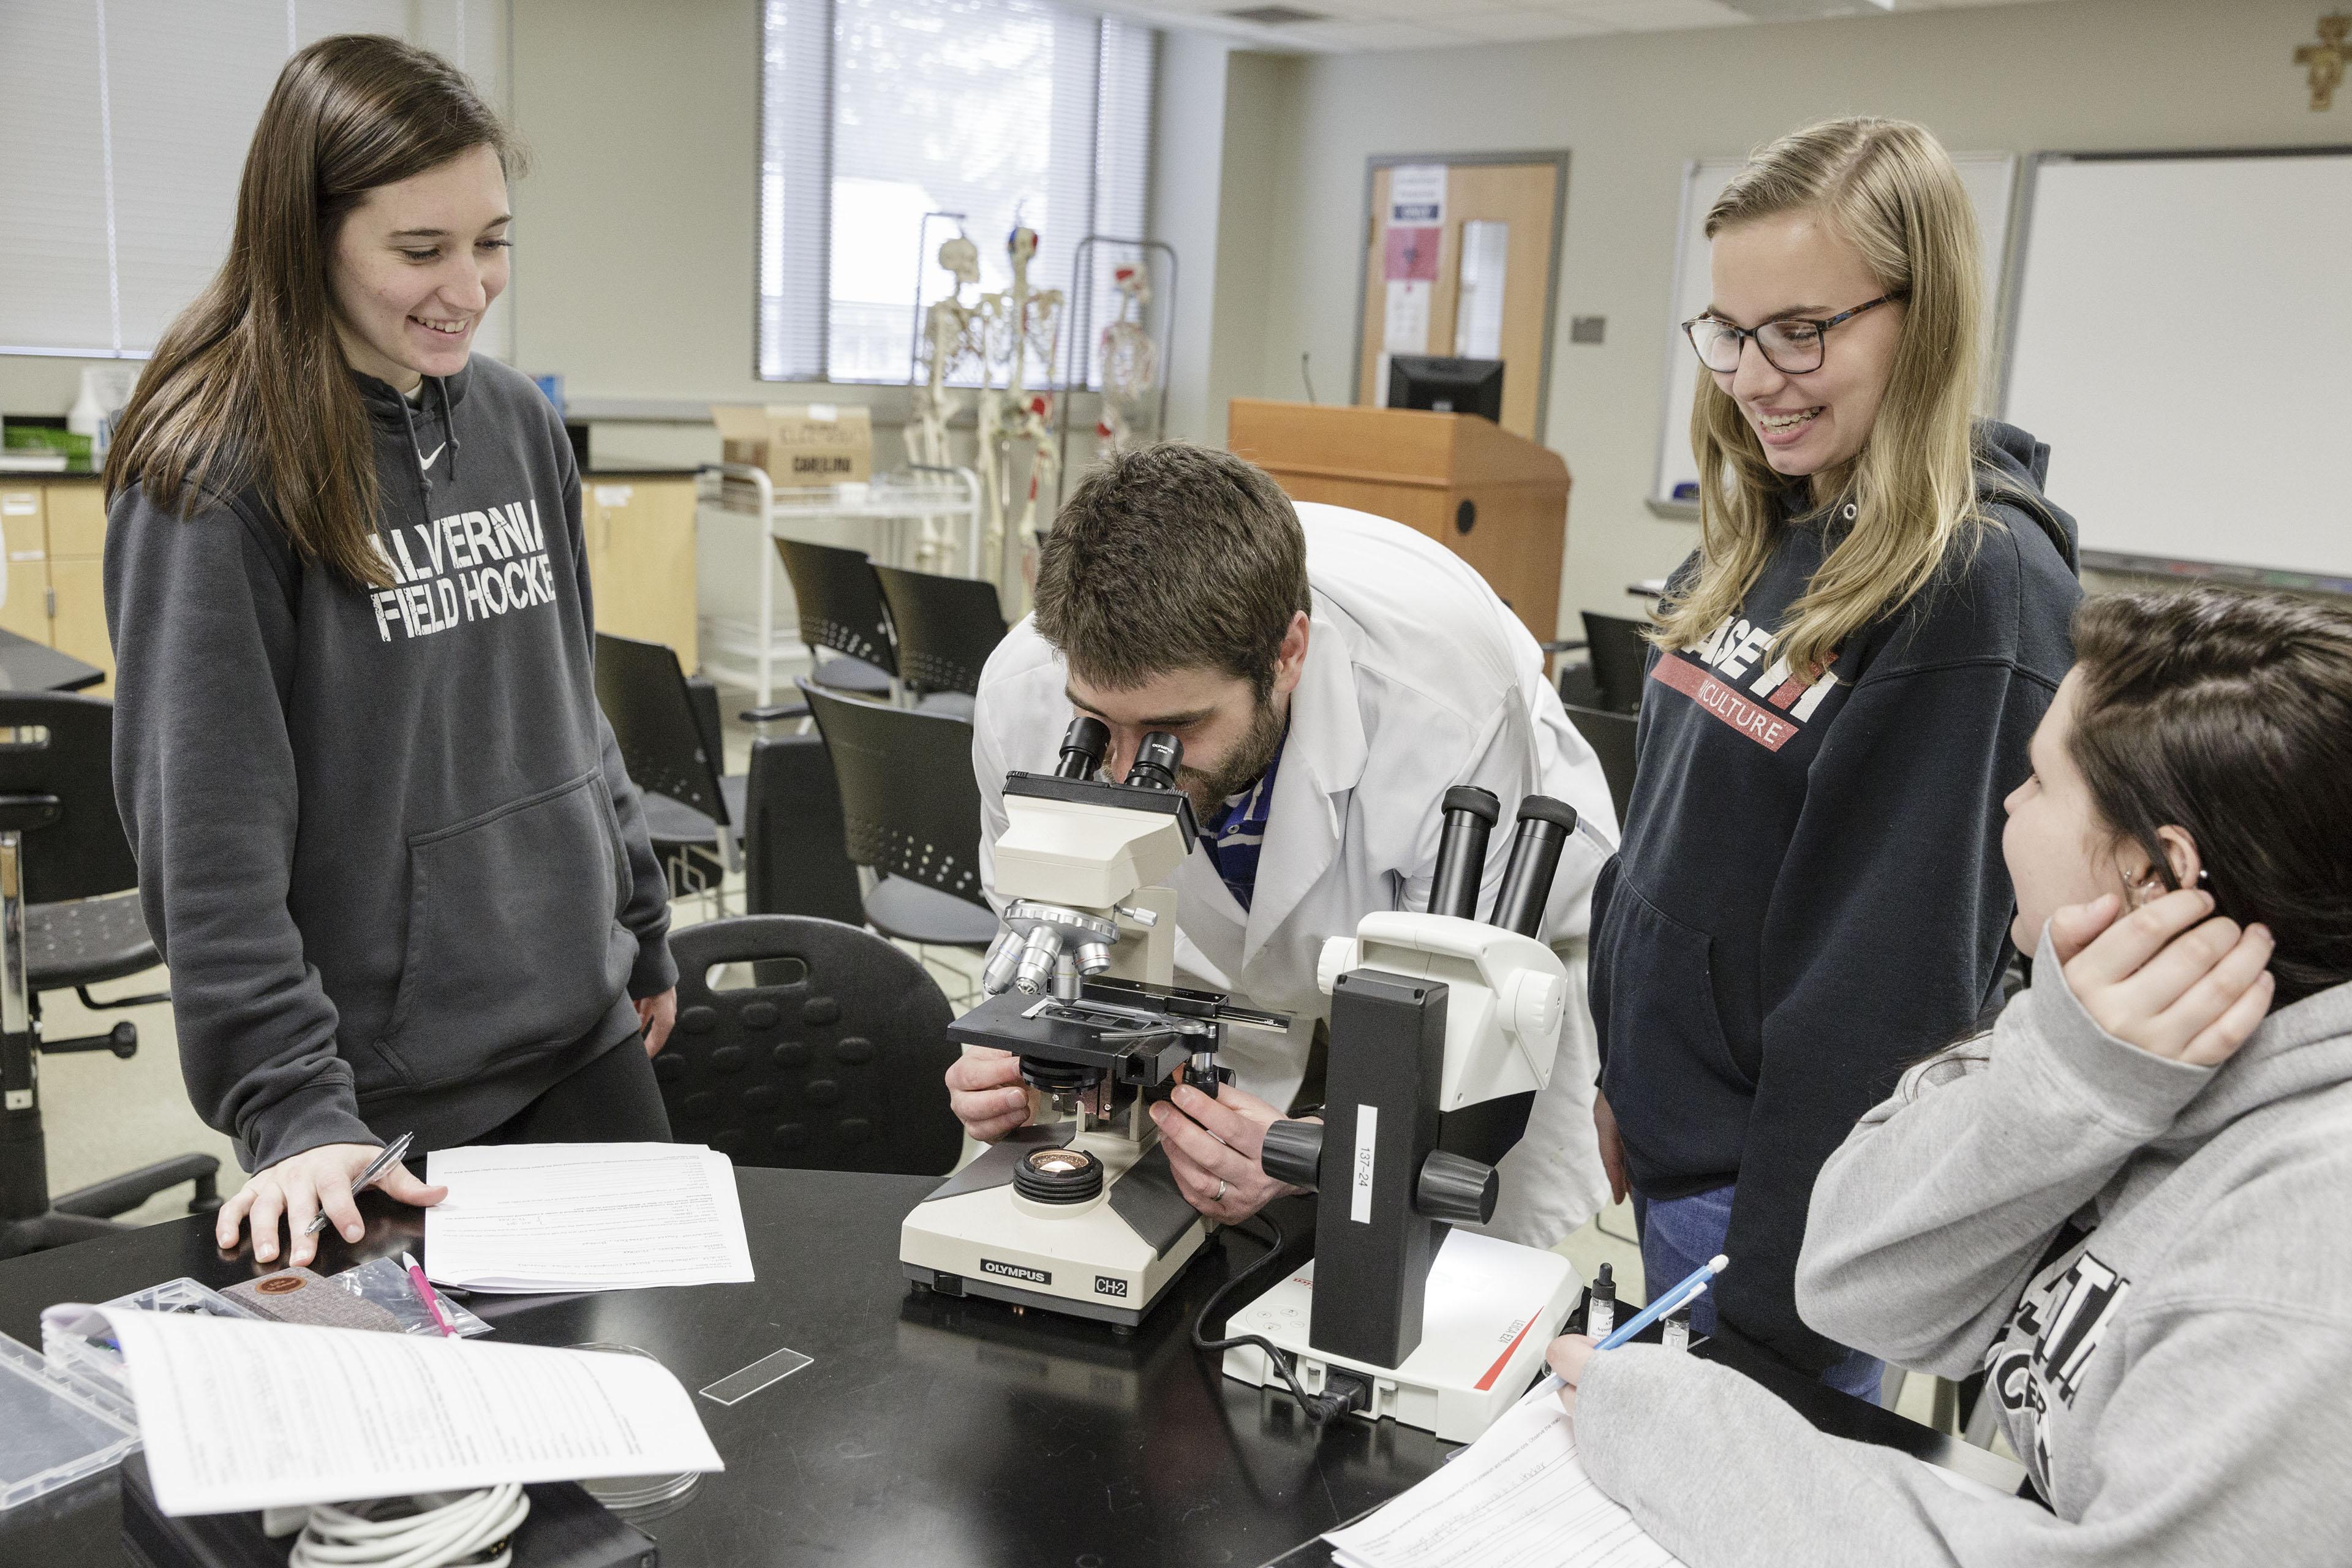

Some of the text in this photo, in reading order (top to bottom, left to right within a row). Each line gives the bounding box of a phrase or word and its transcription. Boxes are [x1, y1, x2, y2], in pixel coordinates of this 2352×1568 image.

[368, 499, 544, 589] ALVERNI
[370, 554, 557, 642] FIELD HOCKE
[1680, 615, 1777, 680] ASE
[1152, 743, 1174, 754] OLYMPUS
[1359, 1147, 1370, 1186] 137-24
[985, 1262, 1045, 1283] OLYMPUS
[1497, 1319, 1526, 1344] LEICA EZ4
[1528, 1430, 1545, 1444] Observe
